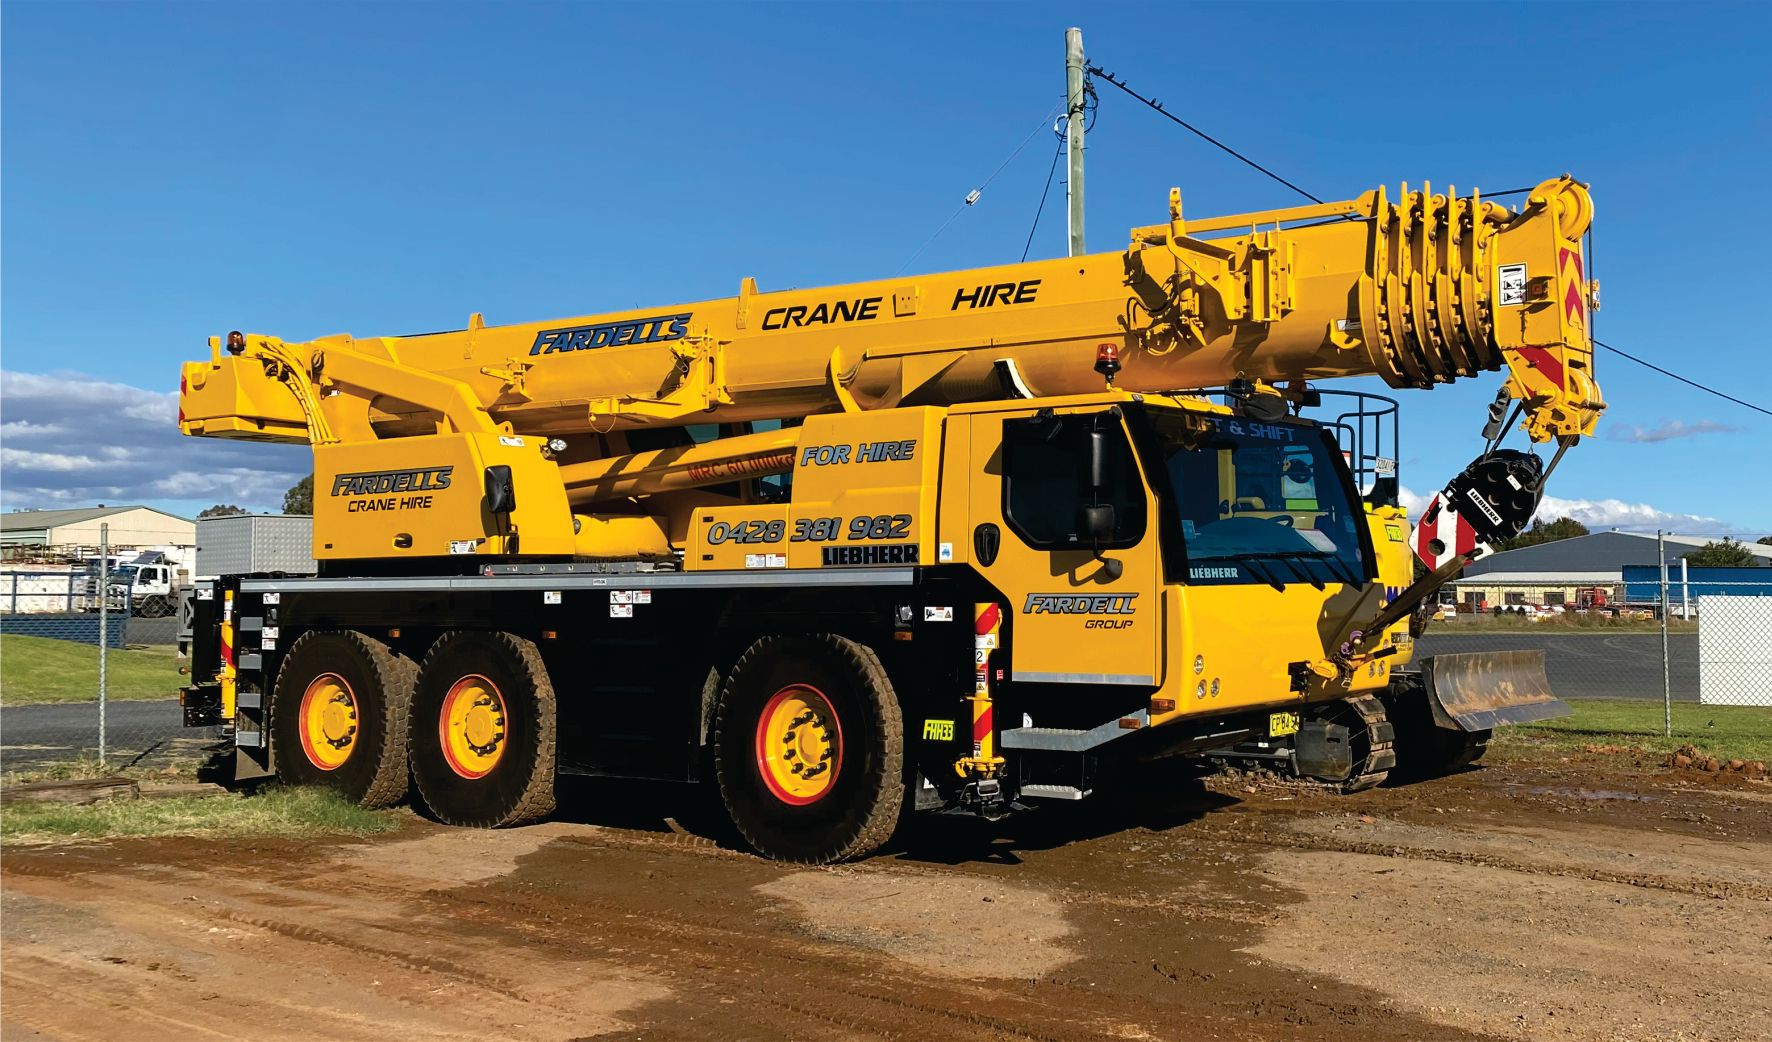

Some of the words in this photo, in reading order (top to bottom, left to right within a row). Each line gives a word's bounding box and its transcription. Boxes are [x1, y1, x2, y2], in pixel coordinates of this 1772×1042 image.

[529, 312, 693, 355] FARDELLS
[761, 296, 884, 330] CRANE
[950, 279, 1042, 311] HIRE
[1229, 420, 1245, 436] &
[1248, 422, 1295, 442] SHIFT
[800, 445, 851, 467] FOR
[855, 439, 917, 463] HIRE
[331, 465, 454, 497] FARDELLS
[688, 463, 724, 482] MRC
[348, 498, 396, 513] CRANE
[399, 496, 433, 510] HIRE
[1470, 490, 1500, 523] LIEBHERR
[708, 519, 786, 545] 0428
[790, 516, 843, 542] 381
[847, 514, 913, 540] 982
[822, 544, 919, 566] LIEBHERR
[1189, 567, 1239, 579] LIEBHERR
[1022, 592, 1139, 615] FARDELL
[1084, 618, 1134, 630] GROUP
[976, 650, 983, 662] 2
